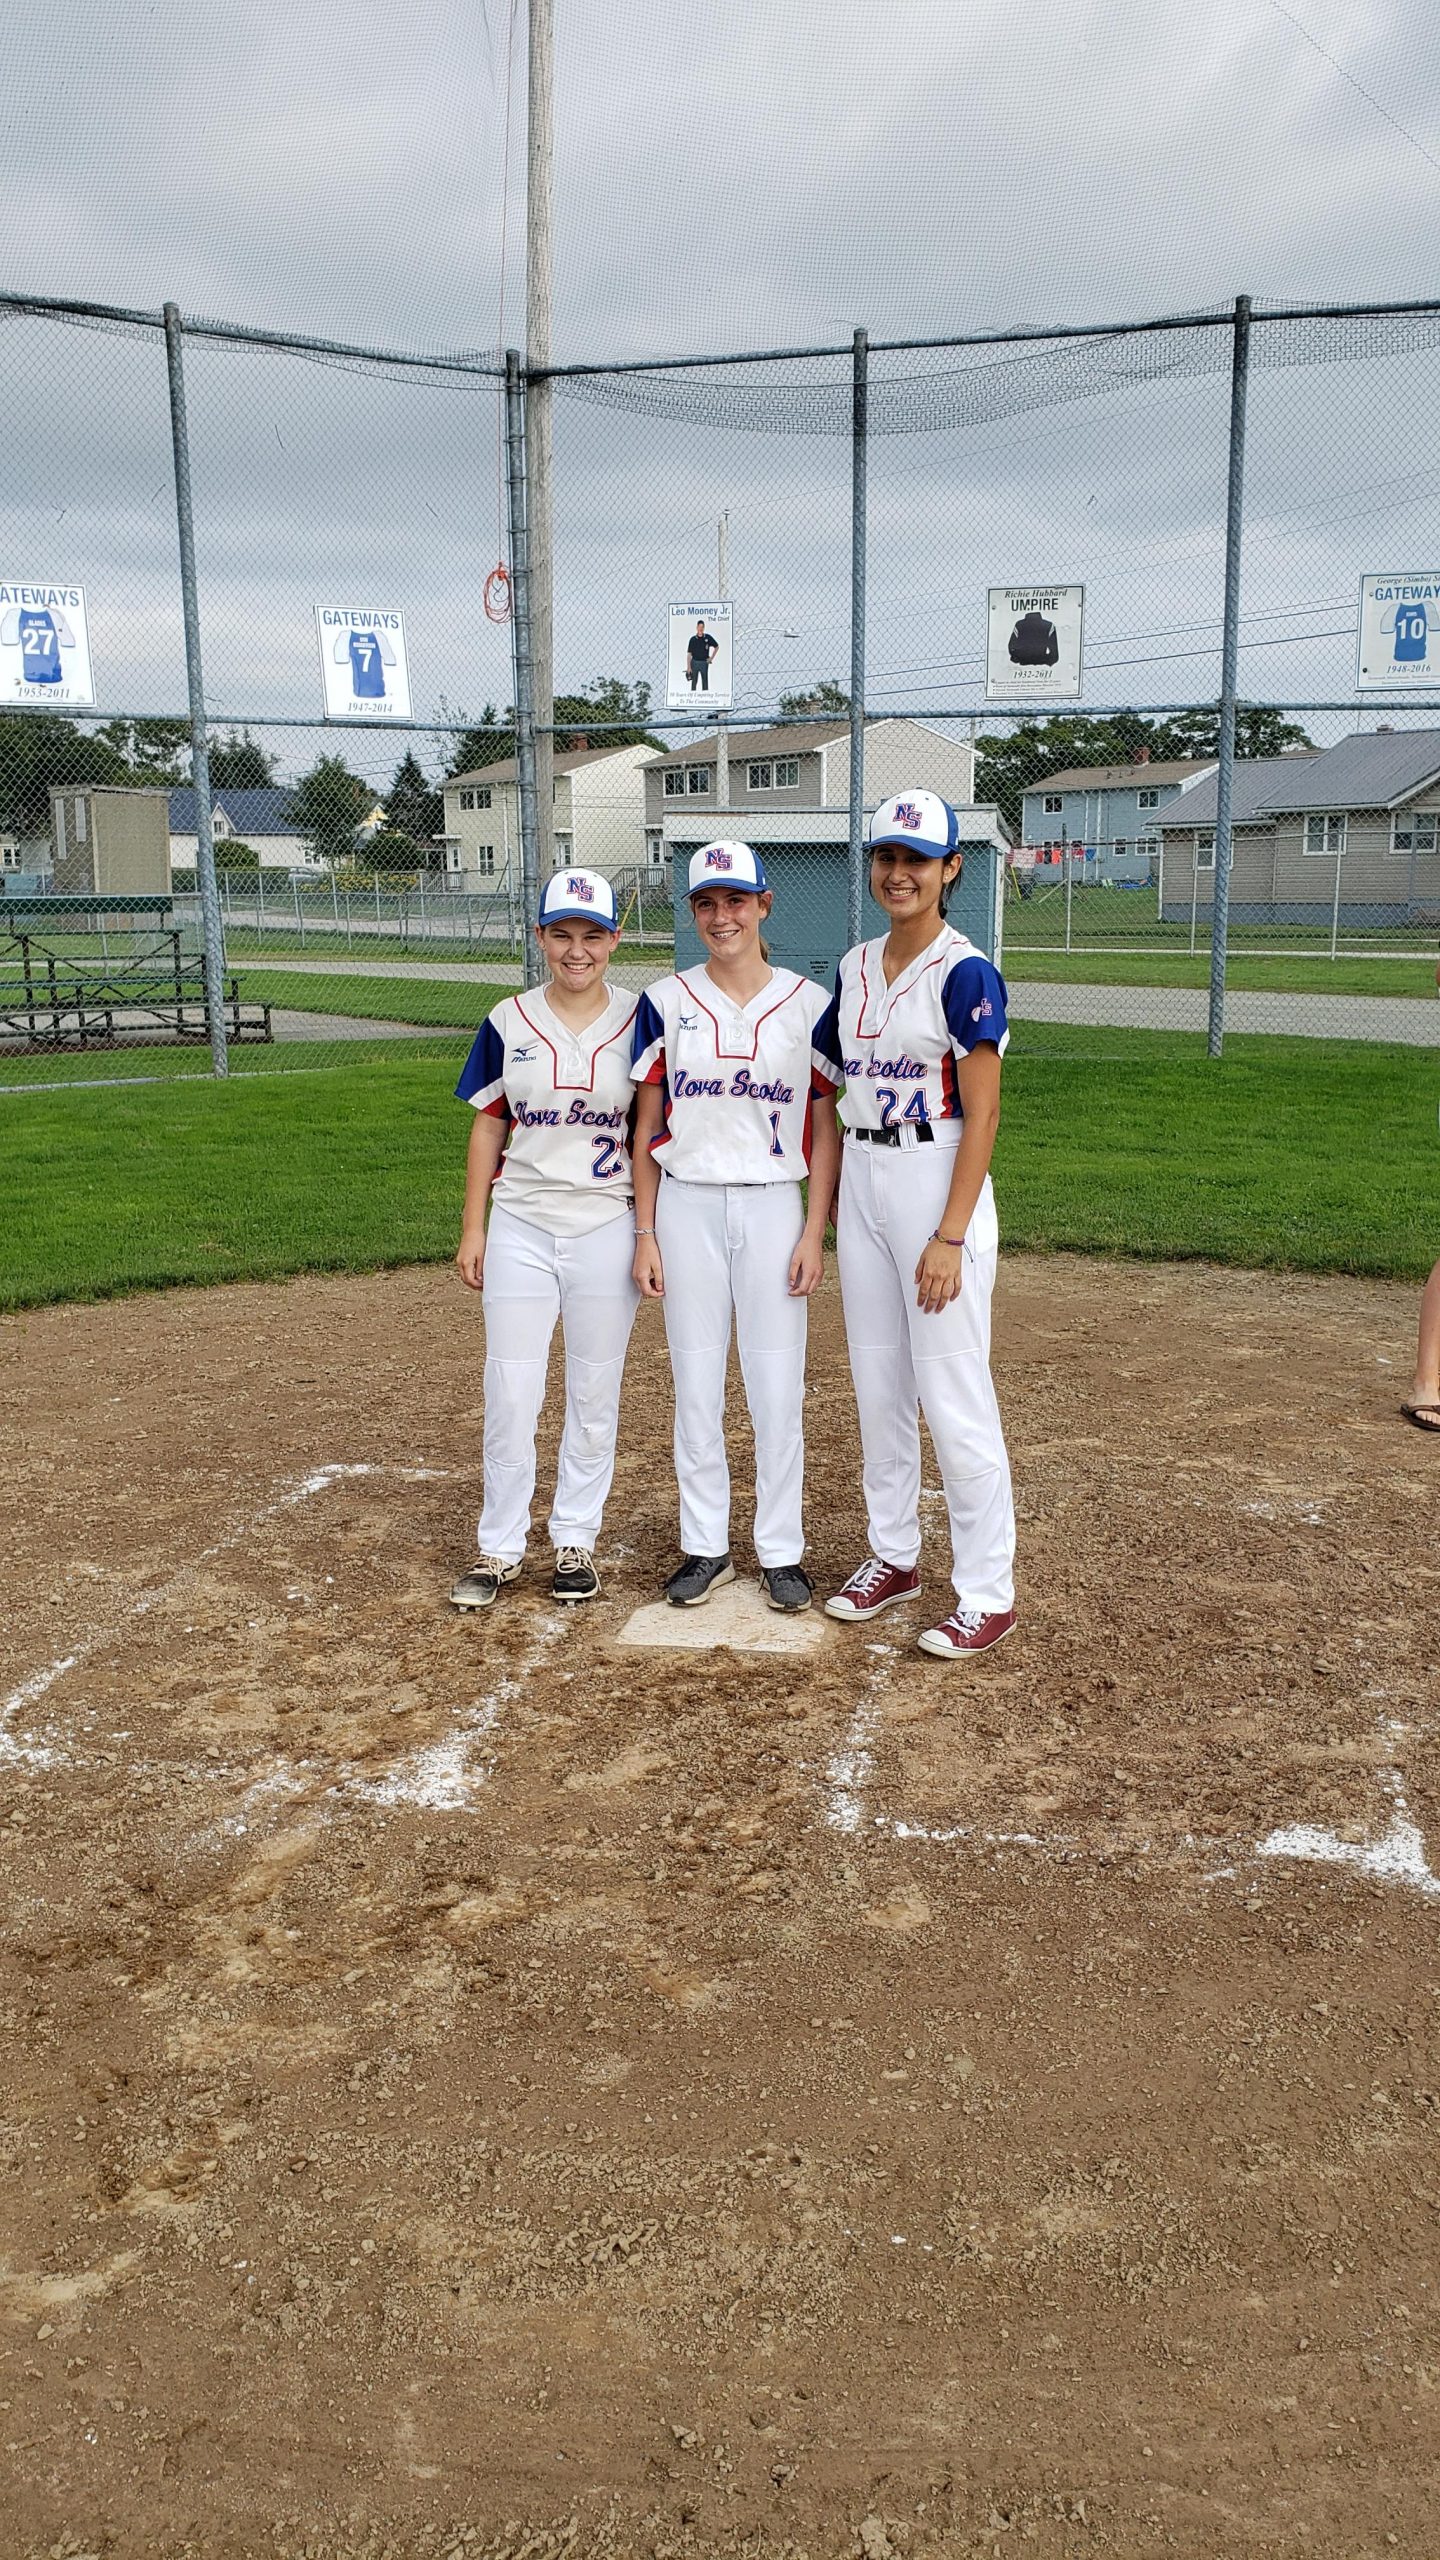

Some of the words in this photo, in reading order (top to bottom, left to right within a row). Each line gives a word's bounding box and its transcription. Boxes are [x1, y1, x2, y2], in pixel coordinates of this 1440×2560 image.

[0, 587, 80, 607] ATEWAYS
[1004, 591, 1030, 599] Richie
[1032, 588, 1068, 598] Hubbard
[1375, 585, 1440, 601] GATEWAY
[671, 607, 685, 616] Leo
[688, 606, 718, 618] Mooney
[720, 605, 731, 616] Jr.
[1011, 598, 1059, 611] UMPIRE
[323, 610, 399, 629] GATEWAYS
[1397, 618, 1425, 639] 10
[22, 628, 55, 655] 27
[358, 649, 372, 672] 7
[1386, 664, 1432, 674] 1948-2016
[1013, 670, 1053, 679] 1932-2011
[18, 687, 71, 699] 1953-2011
[348, 702, 393, 713] 1947-2014
[893, 803, 922, 830] NS
[705, 848, 733, 871] NS
[567, 877, 594, 903] NS
[674, 1069, 725, 1099] Nova
[729, 1068, 795, 1105] Scotia
[514, 1100, 561, 1127] Nova
[875, 1087, 931, 1130] 24
[768, 1110, 785, 1157] 1
